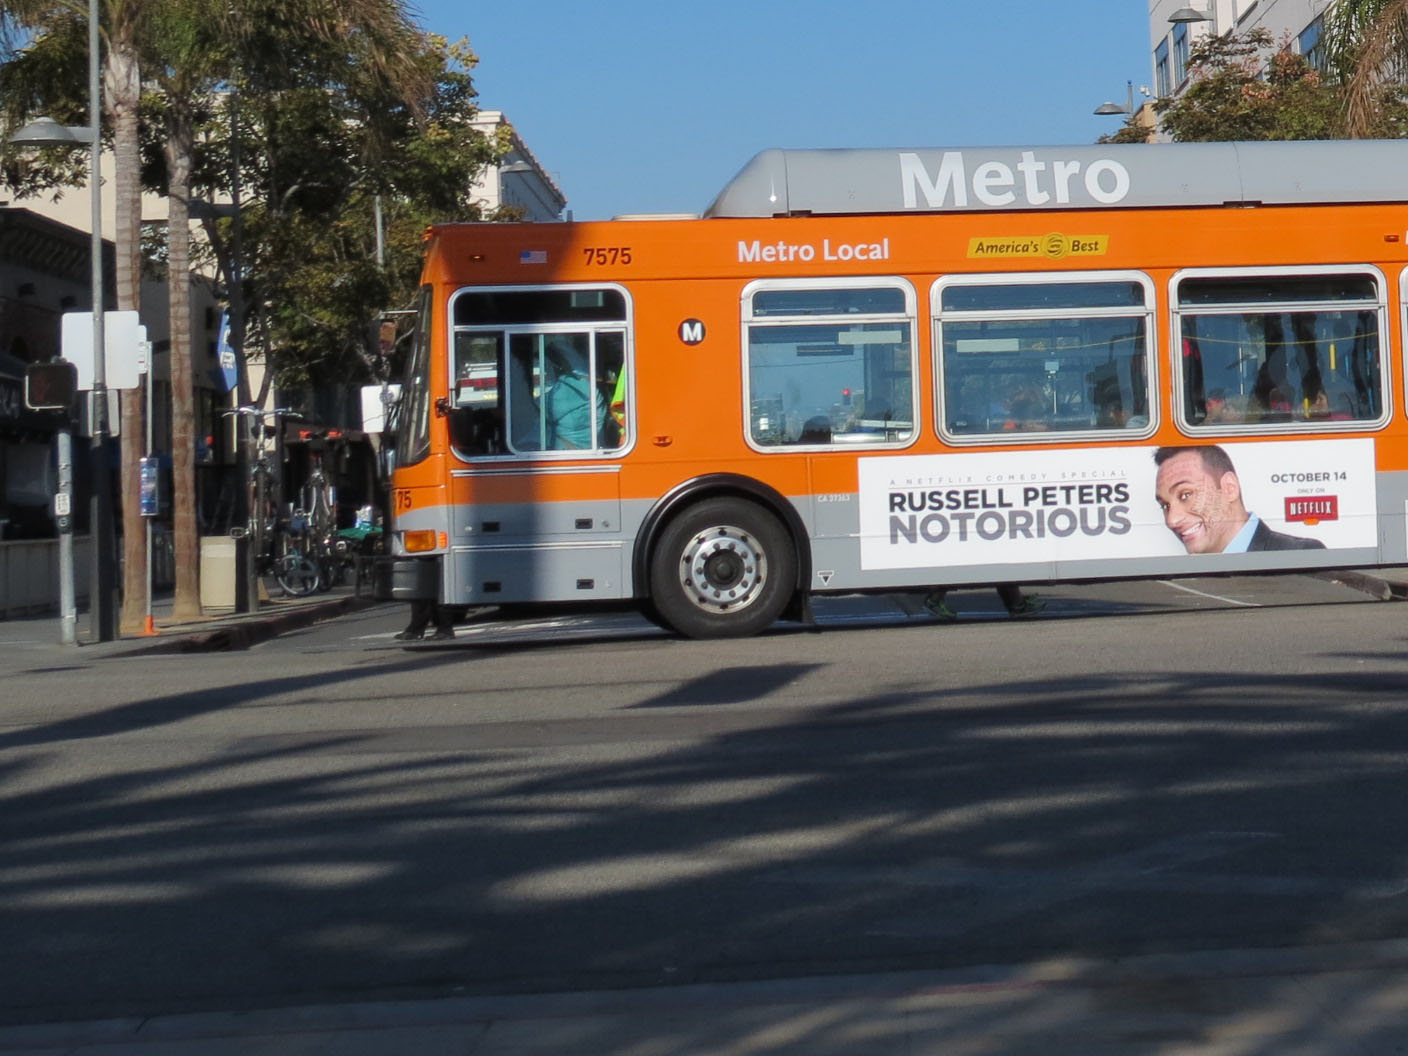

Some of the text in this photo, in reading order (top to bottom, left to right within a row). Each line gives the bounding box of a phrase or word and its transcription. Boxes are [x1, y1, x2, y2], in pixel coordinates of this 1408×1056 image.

[899, 151, 1130, 208] Metro
[737, 238, 889, 262] Metro Local
[975, 241, 1039, 254] America's
[1071, 239, 1099, 252] Best
[583, 248, 632, 265] 7575
[682, 322, 702, 341] M
[986, 473, 1048, 482] COMEDY
[1061, 470, 1126, 479] SPECIAL
[1271, 471, 1347, 484] OCTOBER 14
[889, 483, 1130, 513] RUSSELL PETERS
[1290, 501, 1332, 516] NETFLIX
[889, 505, 1132, 545] NOTORIOUS
